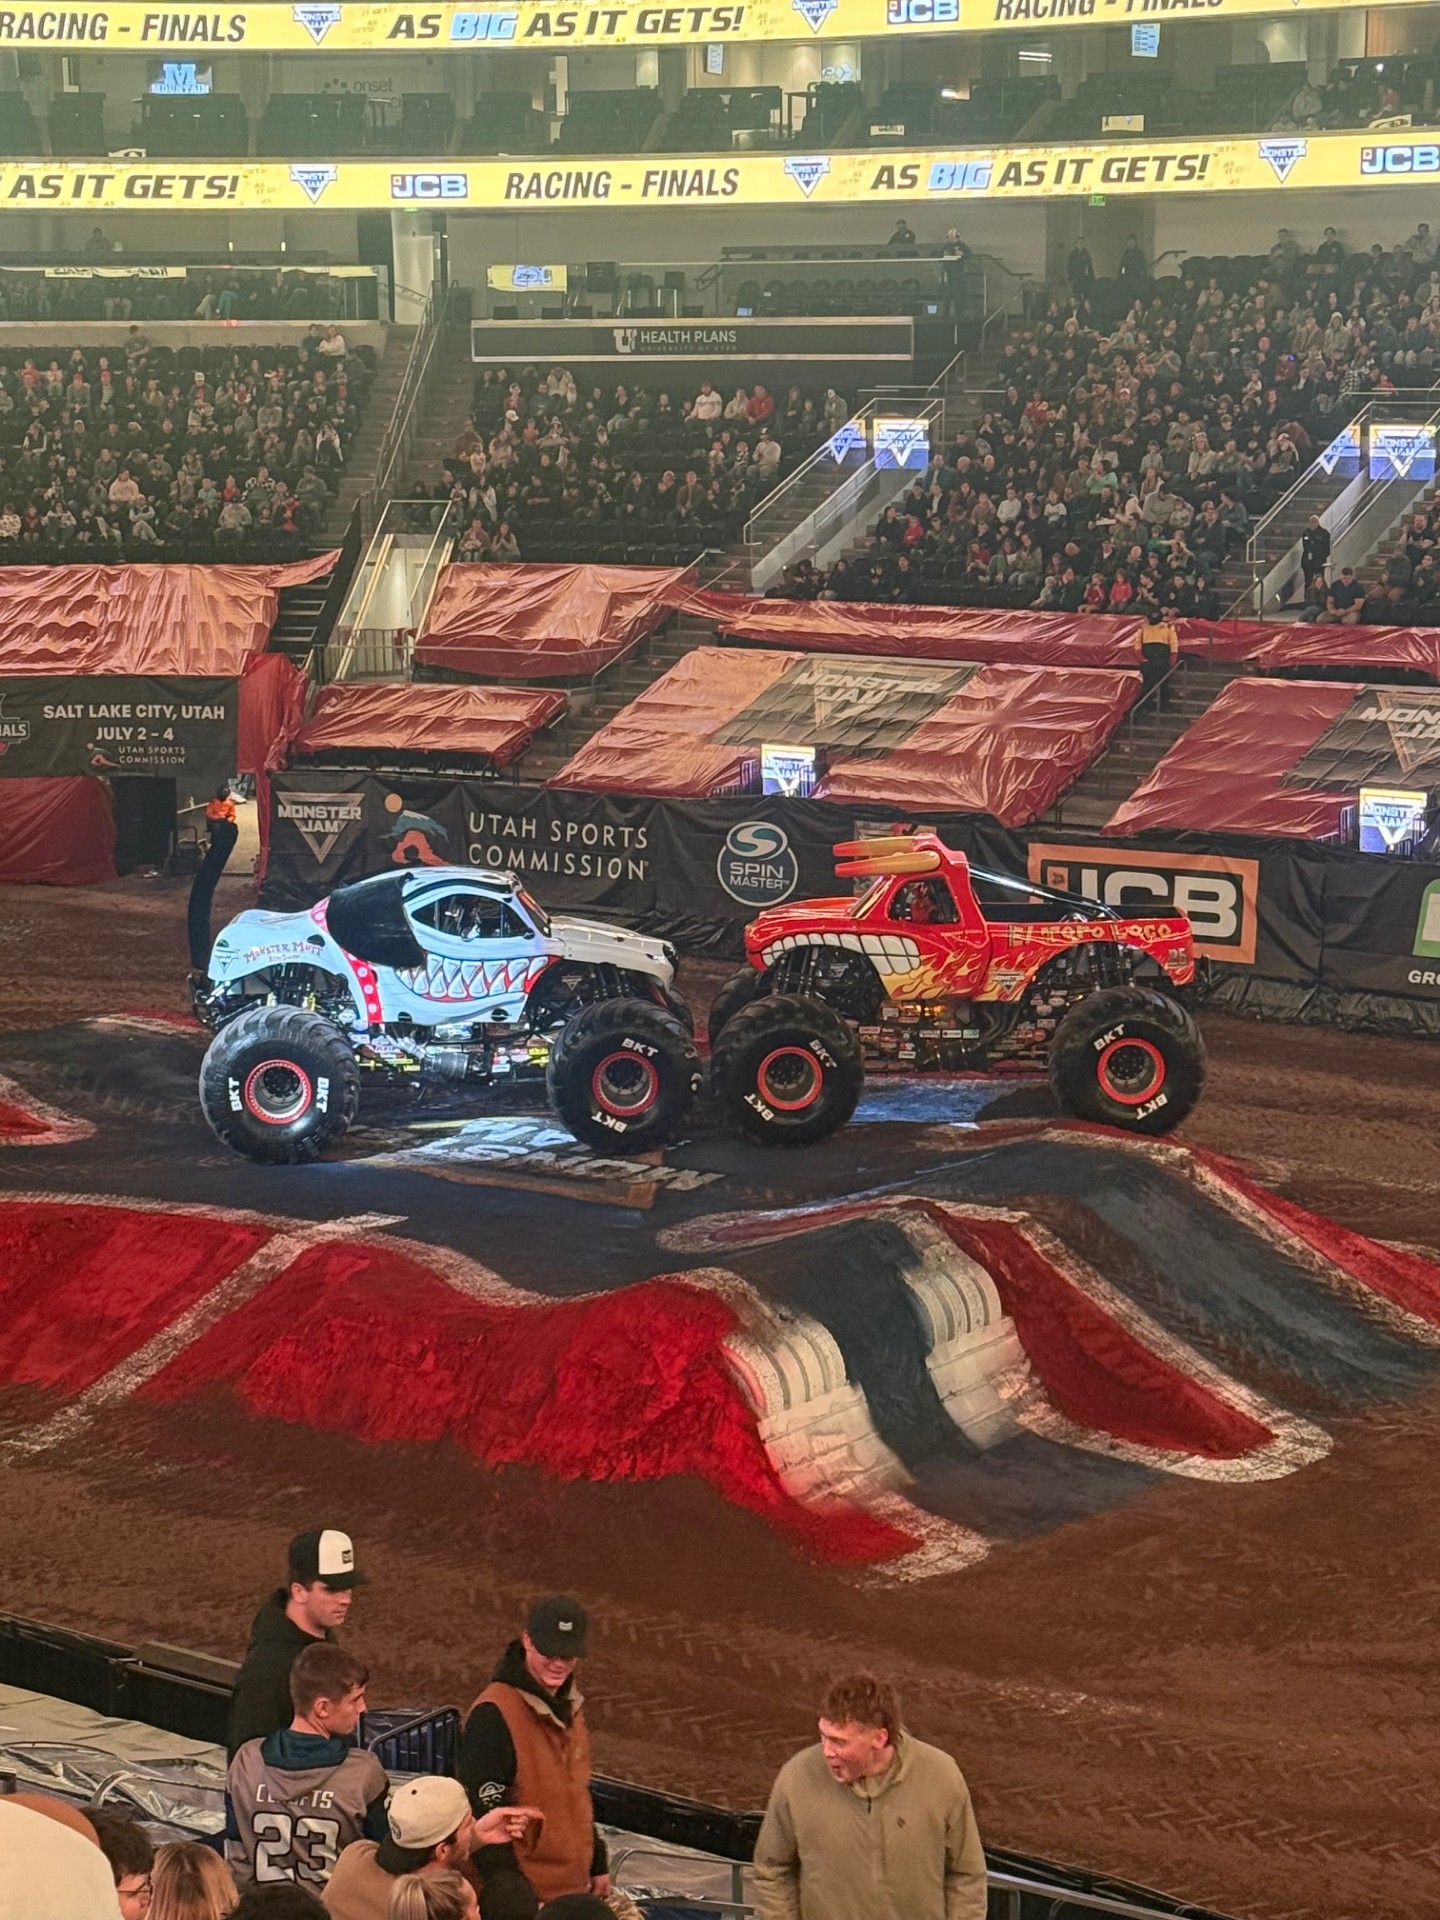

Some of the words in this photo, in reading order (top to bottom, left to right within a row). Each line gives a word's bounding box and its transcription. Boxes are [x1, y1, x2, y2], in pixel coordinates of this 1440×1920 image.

[888, 0, 958, 23] JCB
[0, 12, 109, 41] RACING
[140, 14, 247, 42] FINALS
[386, 14, 442, 40] AS
[451, 12, 518, 41] BIG
[523, 12, 578, 38] AS
[585, 10, 627, 36] IT
[636, 6, 745, 34] GETS!
[354, 78, 392, 93] onset
[1259, 147, 1306, 158] MONSTER
[1271, 156, 1296, 166] JAM
[1361, 146, 1440, 174] JCB
[870, 165, 921, 190] AS
[928, 160, 992, 191] BIG
[997, 160, 1048, 187] AS
[1053, 157, 1094, 185] IT
[1101, 153, 1210, 184] GETS!
[8, 175, 64, 199] AS
[71, 175, 116, 199] IT
[123, 174, 241, 200] GETS!
[391, 174, 467, 199] JCB
[504, 170, 612, 200] RACING
[641, 168, 740, 198] FINALS
[641, 331, 690, 344] HEALTH
[694, 330, 737, 343] PLANS
[791, 672, 943, 694] MONSTER
[816, 687, 890, 704] JAM
[43, 705, 85, 719] SALT
[89, 704, 131, 719] LAKE
[135, 704, 177, 721] CITY,
[181, 705, 225, 720] UTAH
[1358, 707, 1440, 725] MON
[96, 727, 133, 741] JULY
[137, 728, 147, 740] 2
[162, 728, 174, 741] 4
[118, 746, 146, 754] UTAH
[148, 746, 186, 755] SPORTS
[118, 755, 186, 765] COMMISSION
[277, 804, 362, 820] MONSTER
[1381, 817, 1408, 828] JAM
[298, 818, 342, 834] JAM
[468, 811, 537, 839] UTAH
[550, 819, 649, 850] SPORTS
[730, 861, 785, 878] SPIN
[1407, 969, 1440, 987] GR
[621, 1037, 659, 1057] BKT
[1093, 1022, 1126, 1051] BKT
[808, 1039, 838, 1068] BKT
[228, 1076, 243, 1112] BKT
[315, 1076, 330, 1114] BKT
[743, 1093, 775, 1121] BKT
[1135, 1093, 1169, 1121] BKT
[591, 1111, 628, 1133] BKT
[252, 1811, 341, 1883] 23
